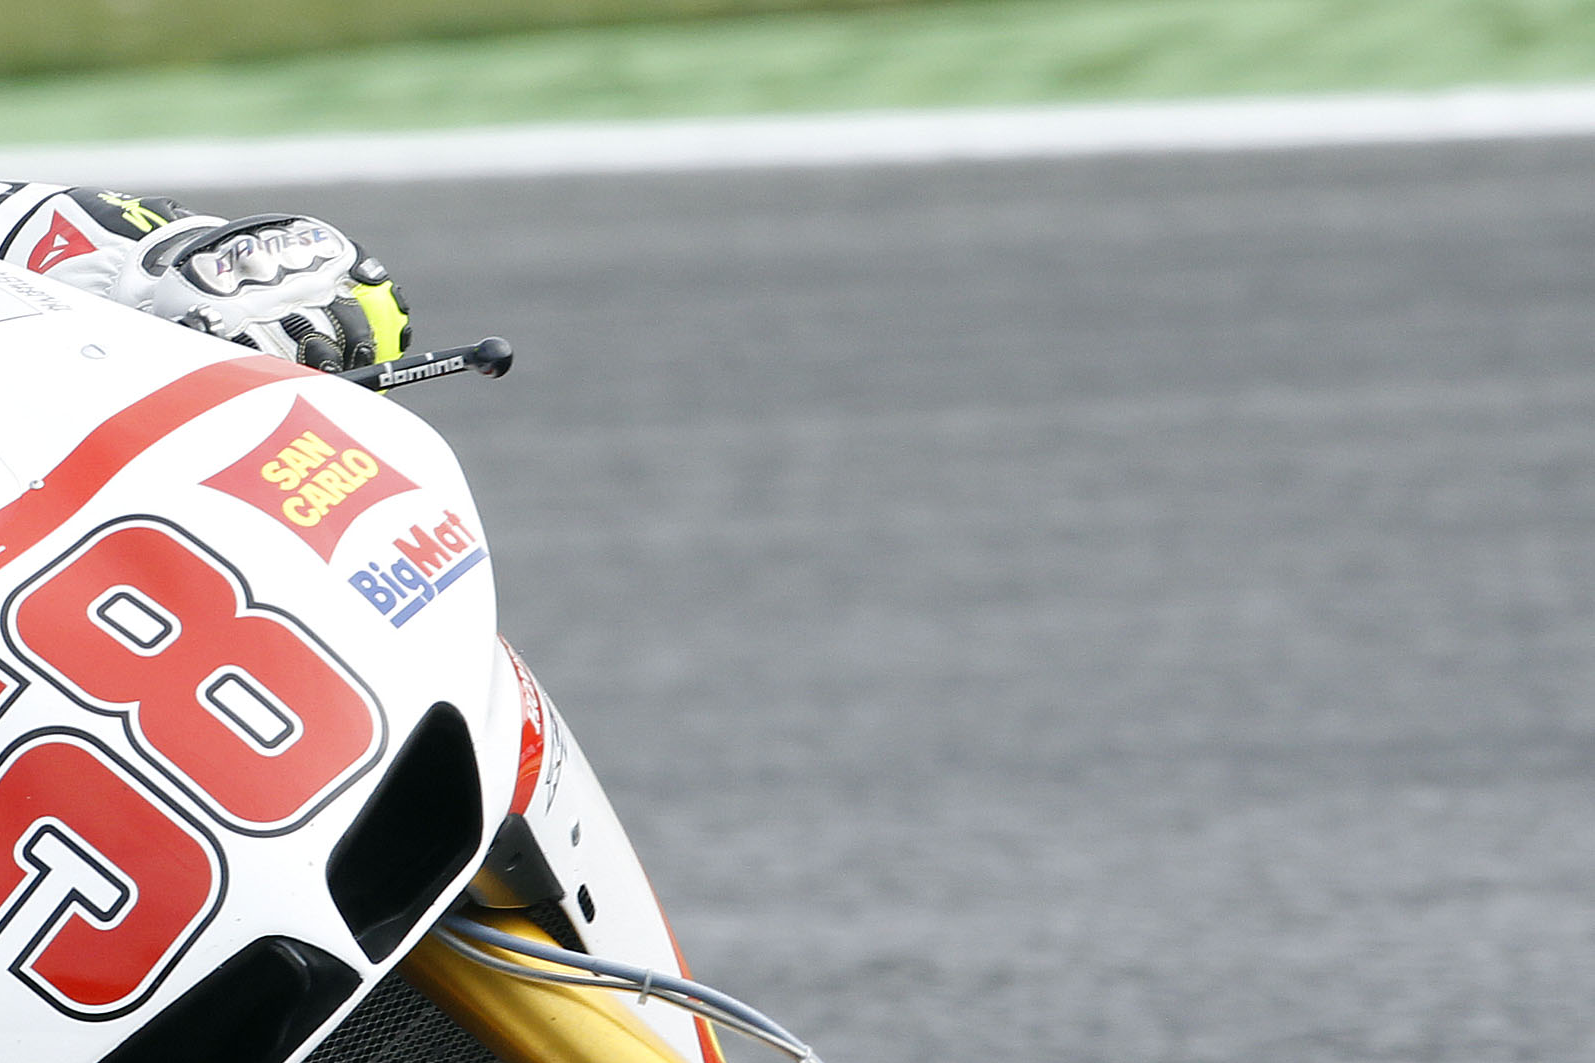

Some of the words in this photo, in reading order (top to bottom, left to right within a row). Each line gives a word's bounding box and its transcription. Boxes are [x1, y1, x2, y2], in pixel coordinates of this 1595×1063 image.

[378, 352, 465, 388] domino
[260, 430, 337, 491] SAN
[281, 448, 380, 528] CARLO
[347, 509, 477, 617] BigMat
